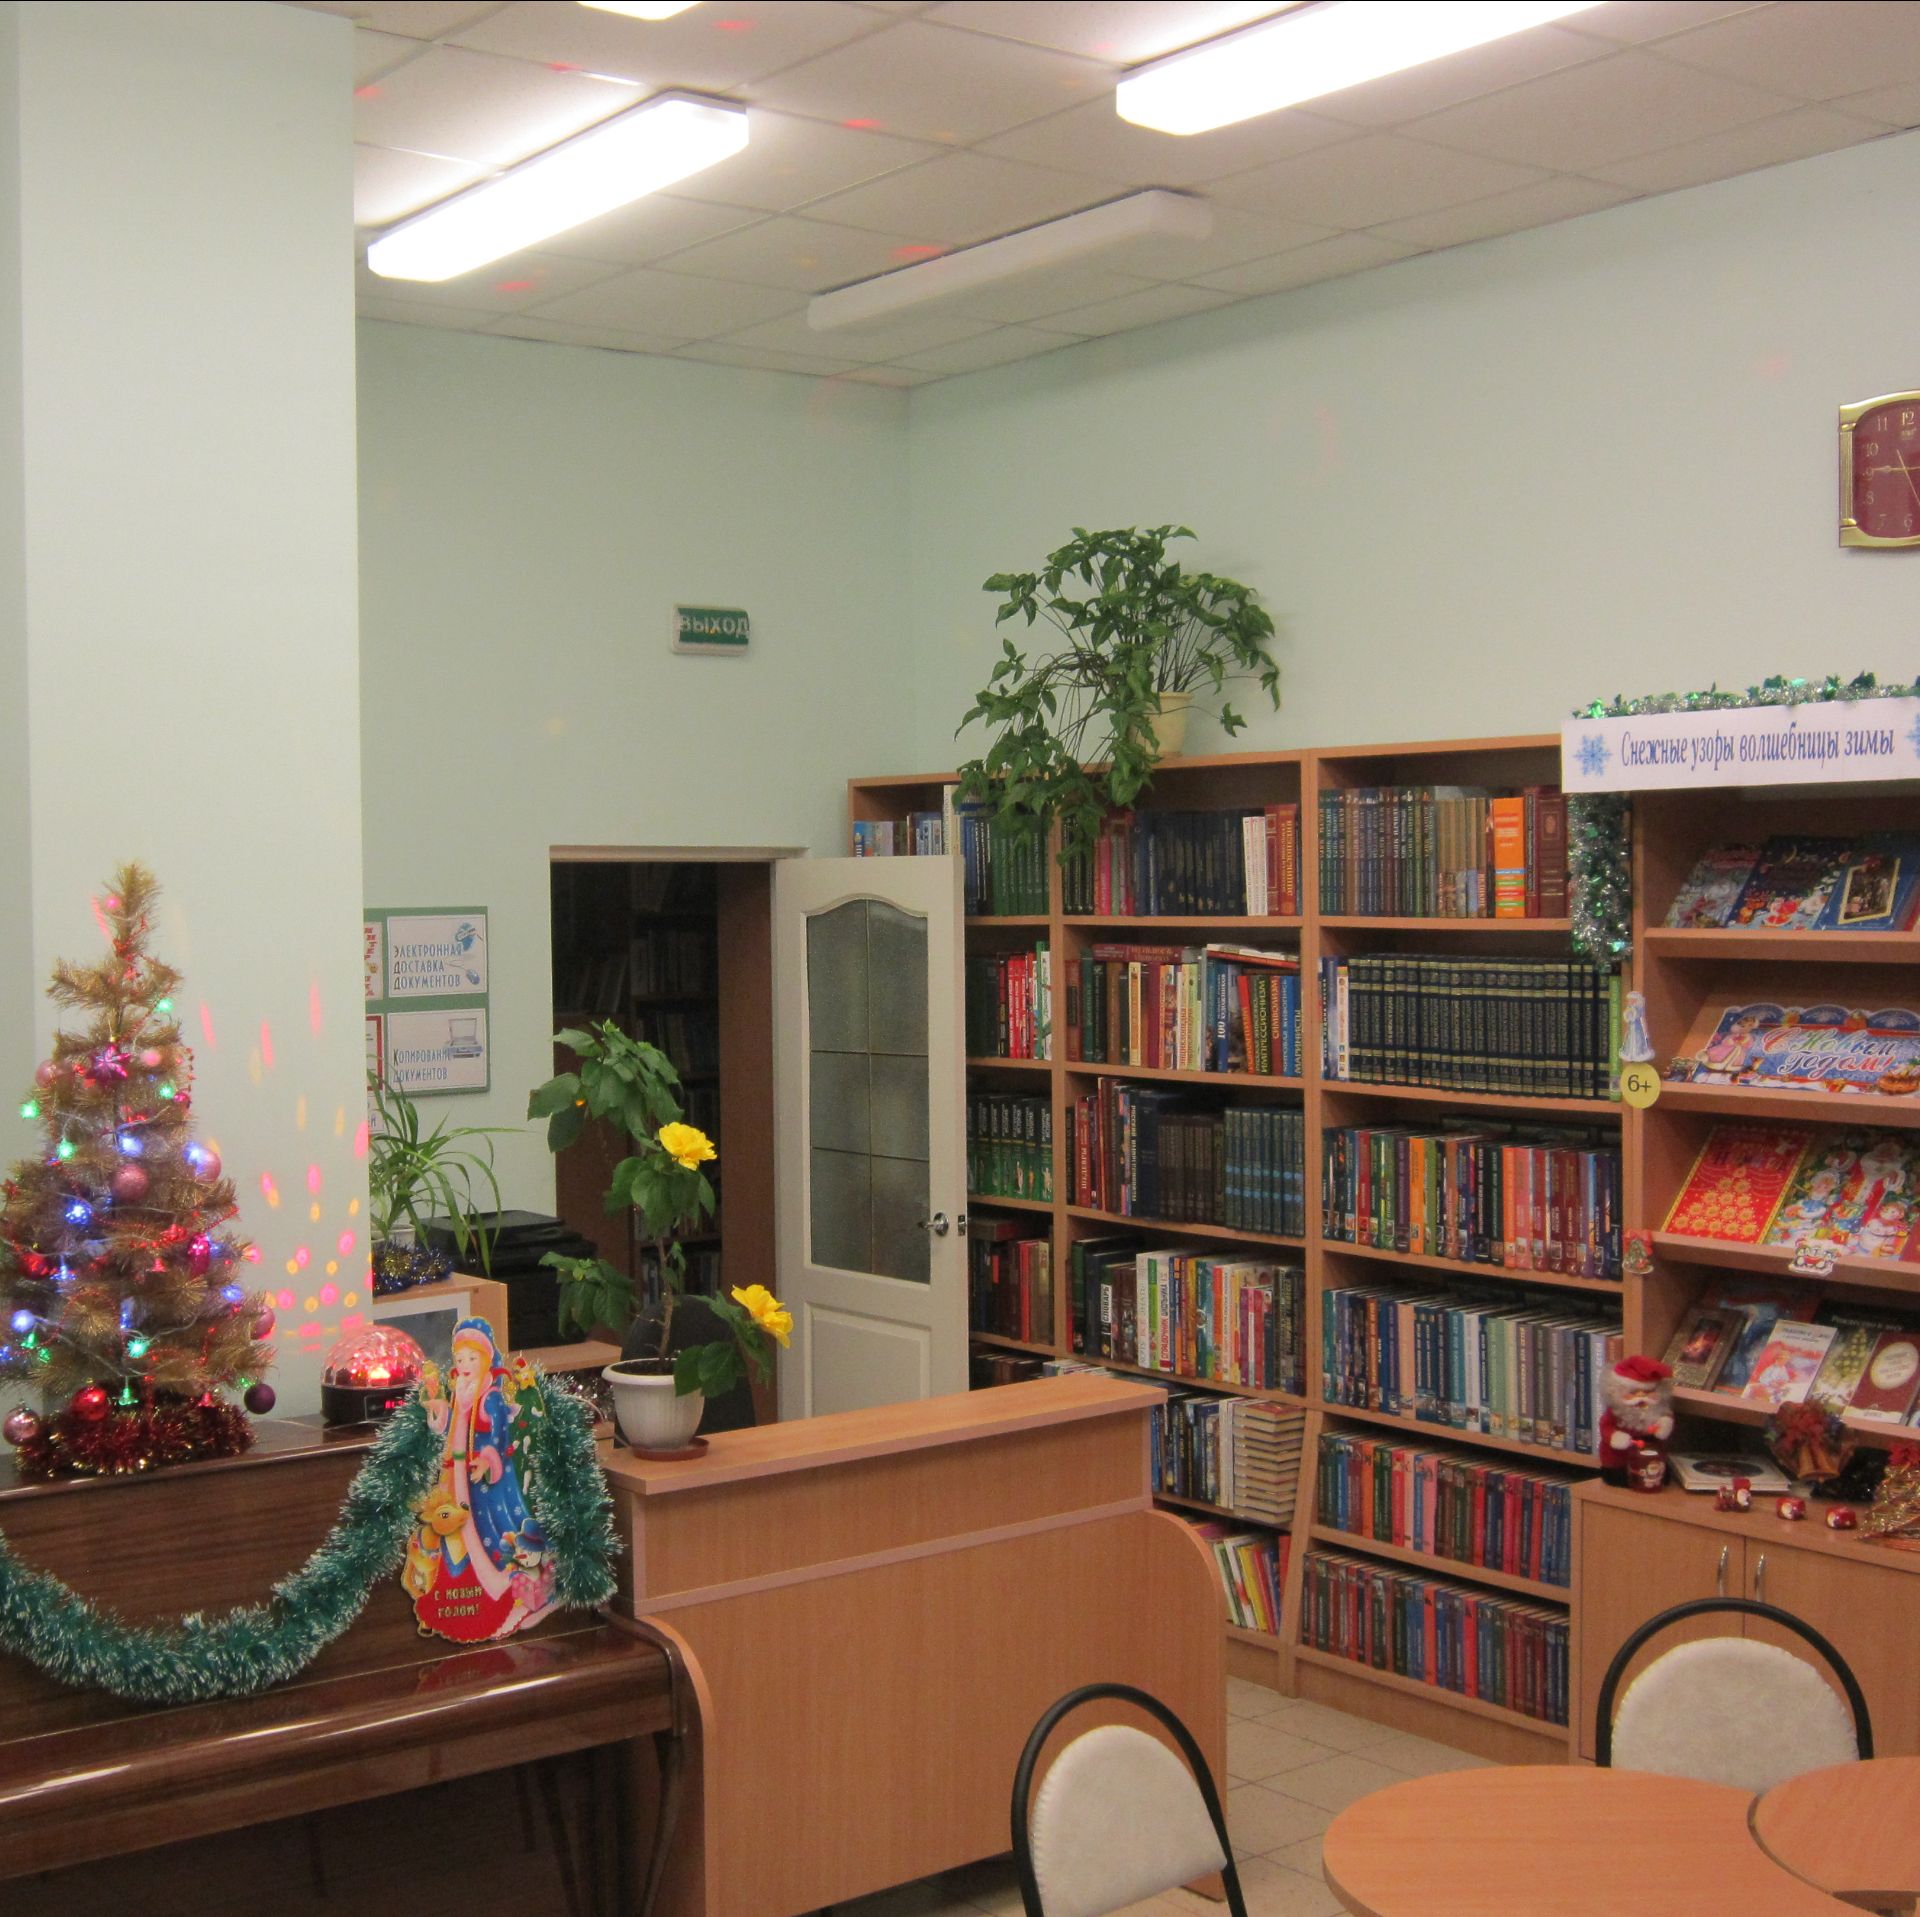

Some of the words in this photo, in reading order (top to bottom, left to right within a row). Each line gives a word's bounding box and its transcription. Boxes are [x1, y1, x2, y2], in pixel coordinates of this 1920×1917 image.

[1877, 416, 1888, 431] 11
[1902, 411, 1914, 426] 12
[680, 614, 749, 639] ВЫХОД
[1621, 731, 1688, 767] Снежные
[1690, 729, 1735, 771] узоры
[1739, 721, 1840, 769] волшебницы
[1844, 728, 1895, 756] зимы
[394, 943, 463, 958] ЭЛЕКТРОННАЯ
[393, 960, 445, 974] ДОСТАВКА
[393, 974, 461, 990] ДОКУМЕНТОВ
[1271, 980, 1279, 1039] СИМВОЛИЗМ
[1217, 1021, 1226, 1039] 100
[1259, 980, 1268, 1073] ИМПРЕССИОНИЗМ
[1294, 1009, 1302, 1074] МАРИНИСТЫ
[1627, 1074, 1652, 1093] 6+
[1101, 1286, 1110, 1321] СЛОВАРЬ
[1160, 1318, 1169, 1359] СПРАВОЧНИК
